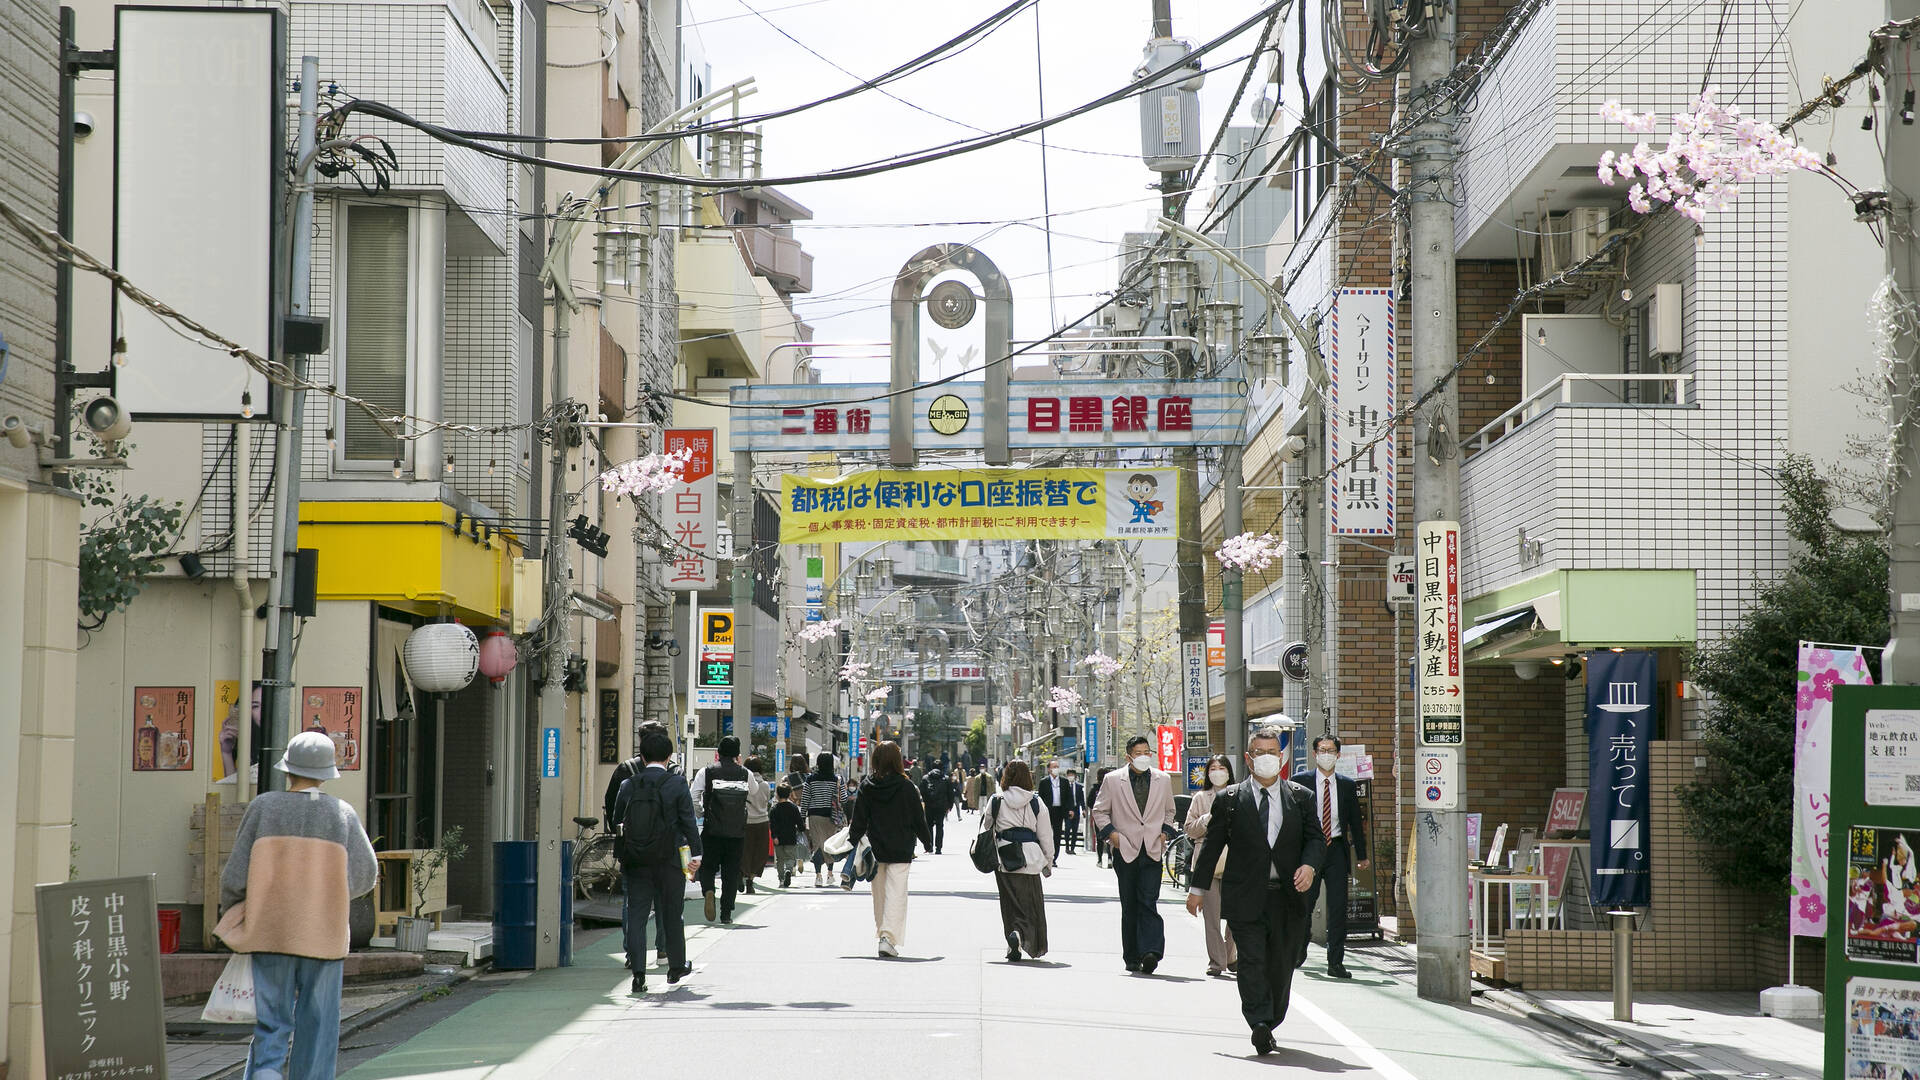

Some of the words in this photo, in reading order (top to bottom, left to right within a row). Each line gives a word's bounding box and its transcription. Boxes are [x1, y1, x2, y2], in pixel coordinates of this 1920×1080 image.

[1356, 312, 1370, 392] ヘアーサロン
[781, 408, 872, 435] 二番街
[1028, 395, 1193, 433] 目黒銀座
[692, 437, 709, 473] 時計
[1346, 405, 1380, 510] 中目黒
[791, 479, 1098, 513] 都税は便利な口座振替で
[671, 487, 706, 583] 白光堂
[1393, 574, 1415, 583] VEN
[1423, 530, 1445, 678] 中目黒不動産
[708, 614, 731, 642] P
[1449, 593, 1458, 674] 不動産のことなら
[707, 661, 730, 685] 空
[1189, 657, 1201, 697] 中村外科
[1423, 686, 1446, 696] こちら
[176, 690, 188, 758] 角ハイボール
[344, 691, 356, 758] 角ハイボール
[1423, 704, 1462, 713] 03-3760-7100
[1553, 799, 1582, 821] SALE
[105, 892, 131, 1001] 中目黒小野
[71, 895, 97, 1054] 皮フ科クリニック
